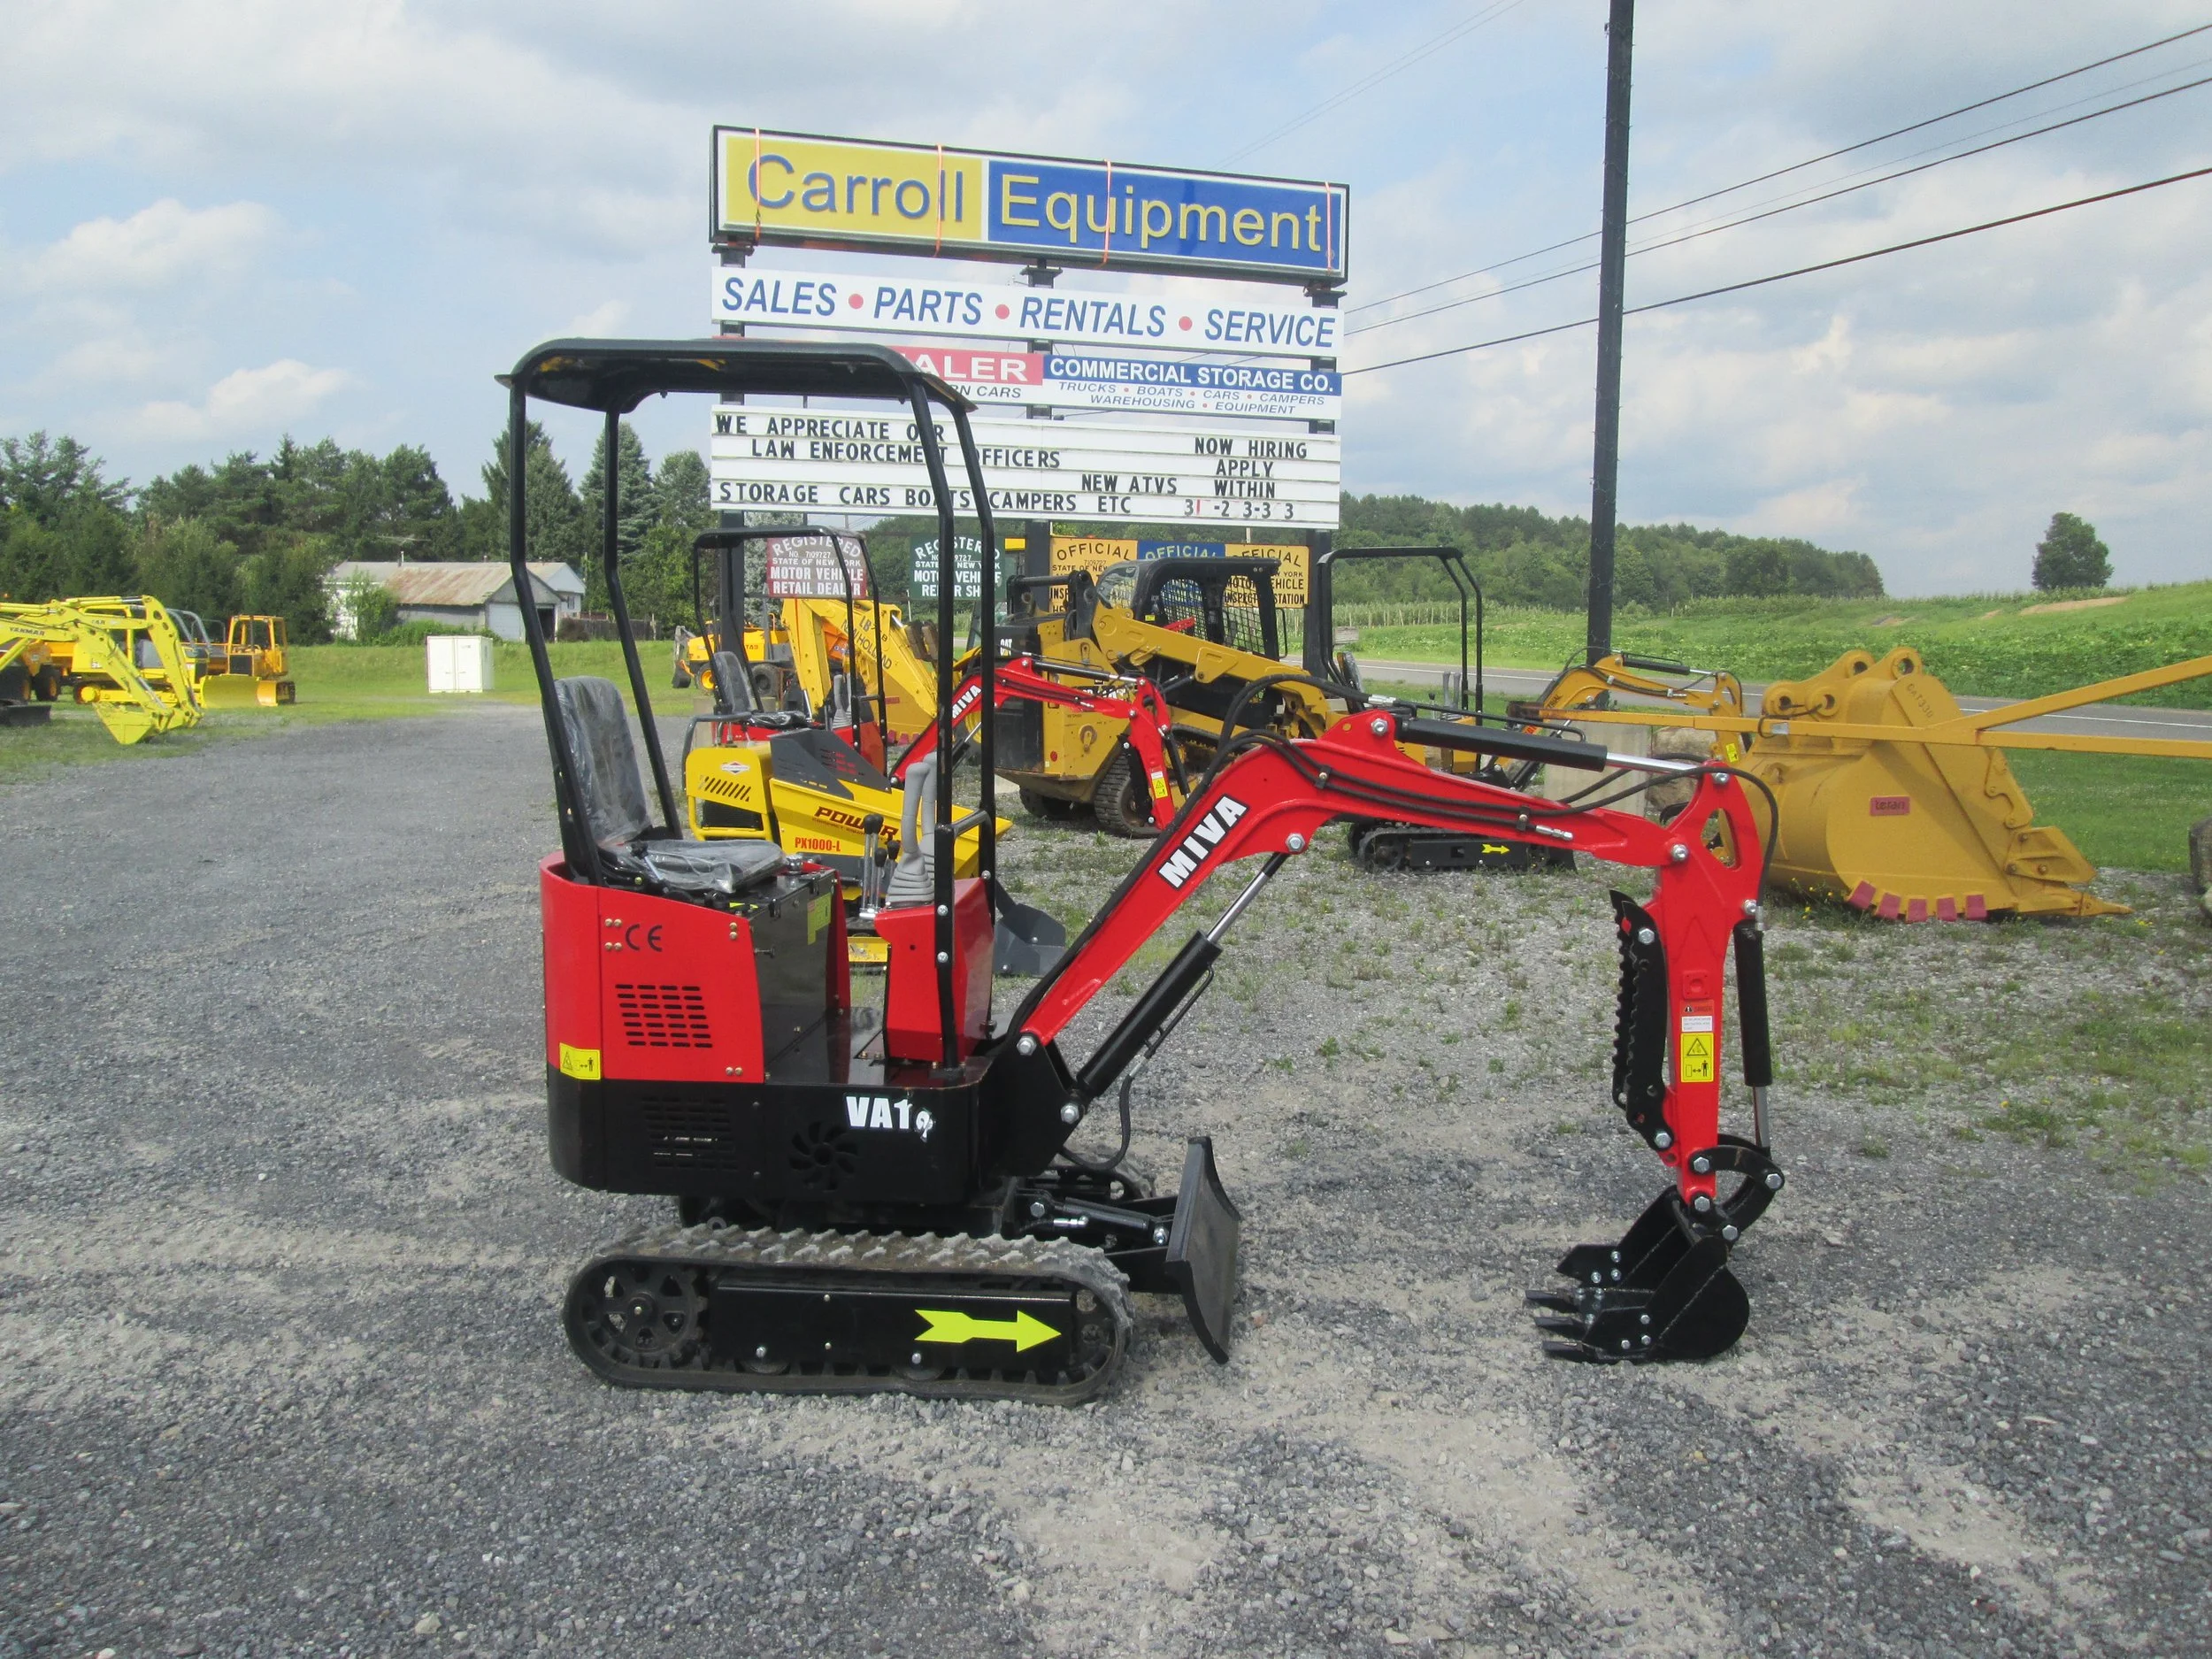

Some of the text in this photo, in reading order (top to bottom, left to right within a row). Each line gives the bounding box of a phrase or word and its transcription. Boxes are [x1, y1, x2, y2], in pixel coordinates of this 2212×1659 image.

[748, 154, 1322, 252] Carroll Equipment
[722, 277, 1336, 348] SALES PARTS RENTALS SERVICE
[902, 353, 1029, 382] ALER
[1050, 358, 1333, 392] COMMERCIAL STORAGE CO.
[976, 385, 1022, 398] CARS
[1058, 381, 1325, 405] TRUCKS BOATS CARS CAMPERS
[1090, 395, 1295, 415] WAREHOUSING EQUIPMENT
[716, 416, 945, 442] WE APPRECIATE OR
[751, 438, 795, 458] LAW
[810, 442, 948, 464] ENFORCEMET
[1194, 437, 1307, 459] NOW HIRING
[1216, 459, 1273, 479] APPLY
[719, 481, 1132, 514] STORAGE CARS BOTS CAMPERS ETC
[1081, 474, 1276, 499] NEW ATVS WITHIN
[1056, 543, 1131, 561] OFFICIAL
[1233, 549, 1302, 567] FFICIAL
[770, 566, 864, 581] MOTOR VEHILE
[914, 570, 940, 582] MOT
[1271, 578, 1304, 589] EHICLE
[772, 581, 861, 596] RETAIL DEALR
[1274, 594, 1305, 605] STATION
[952, 684, 982, 718] MIVA
[814, 806, 899, 845] POWR
[795, 836, 841, 852] PX1000-L
[1159, 796, 1247, 888] MIVA
[626, 924, 664, 952] CE
